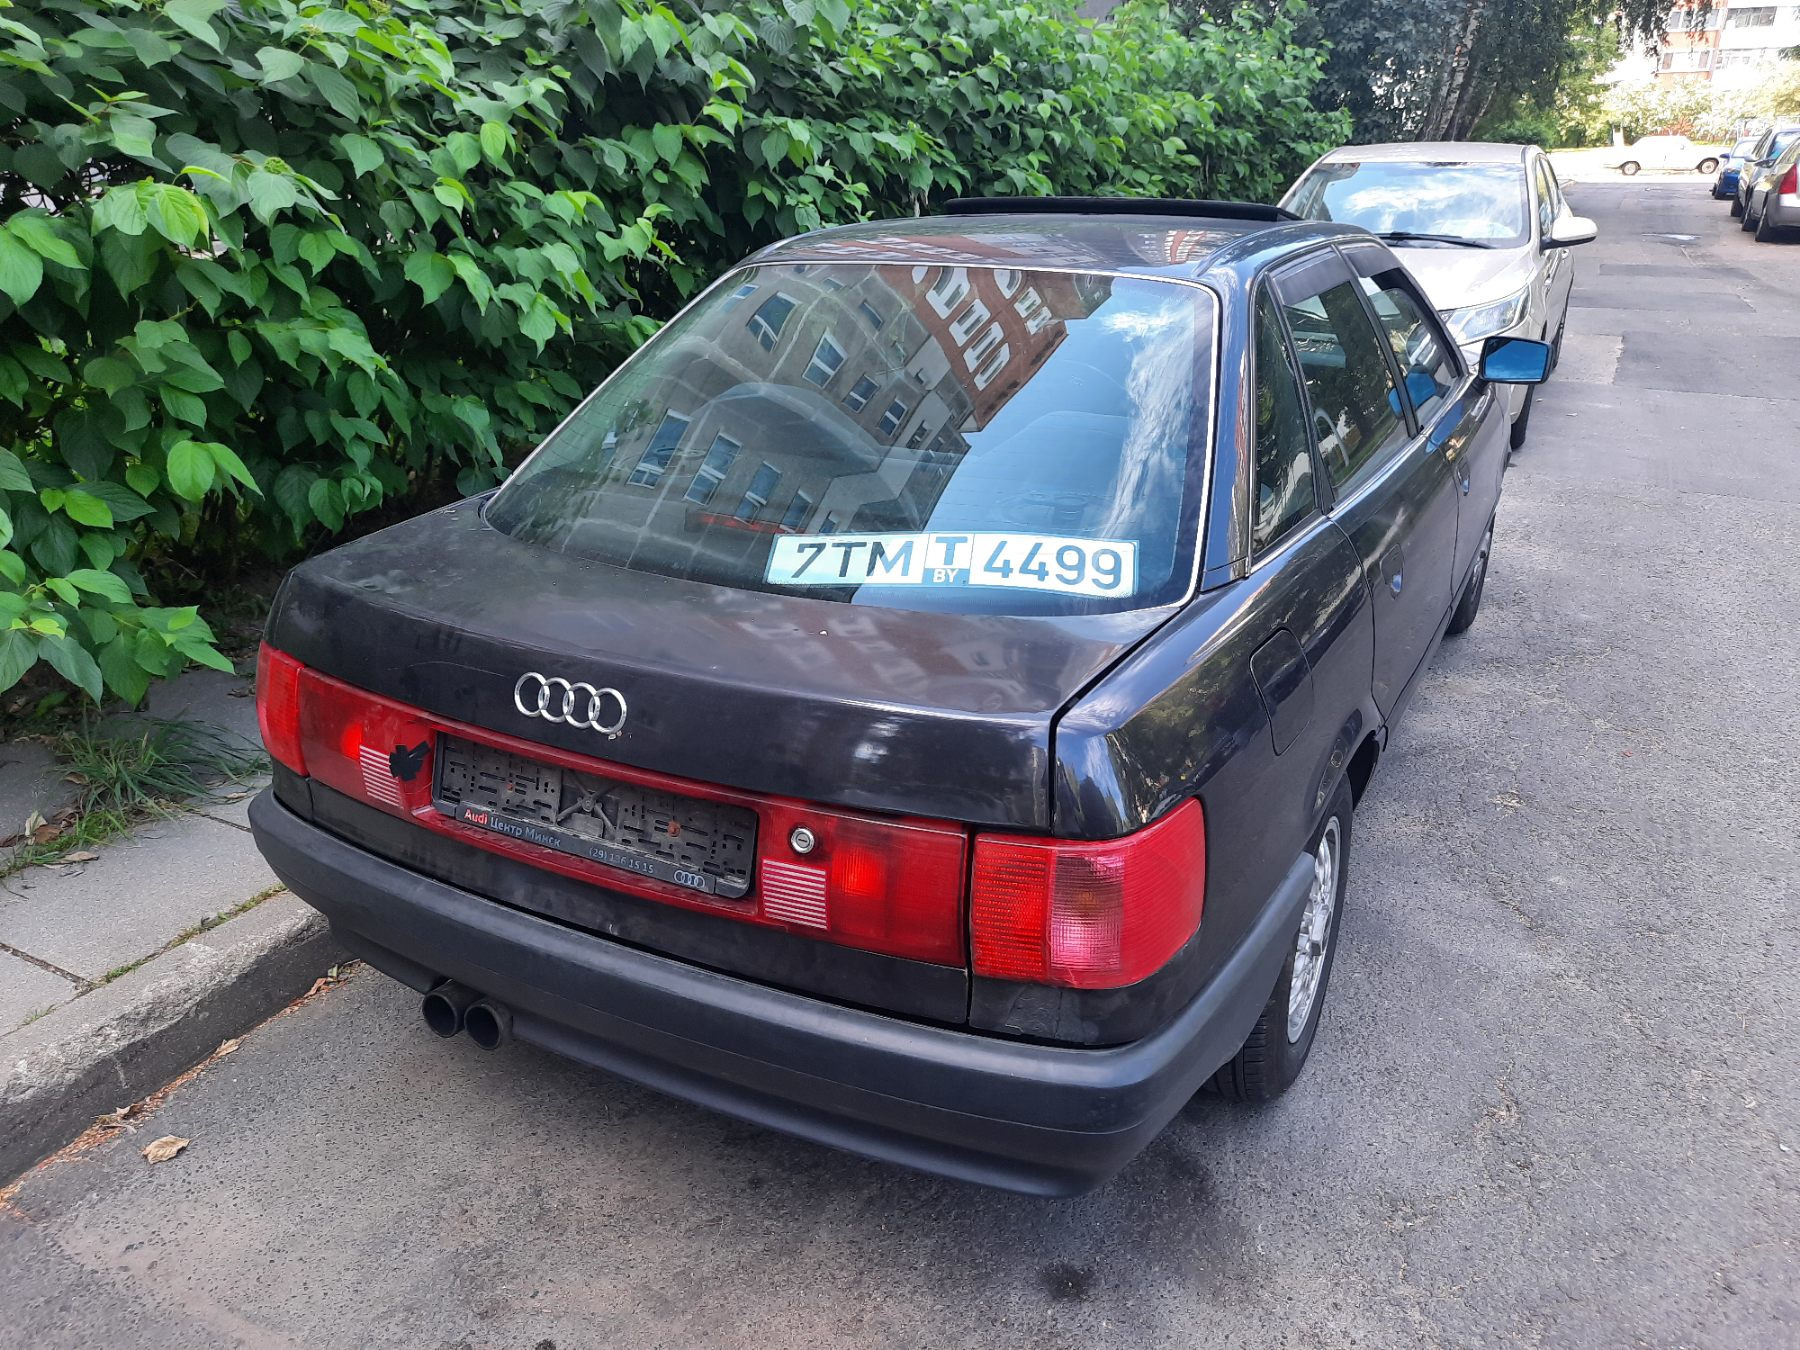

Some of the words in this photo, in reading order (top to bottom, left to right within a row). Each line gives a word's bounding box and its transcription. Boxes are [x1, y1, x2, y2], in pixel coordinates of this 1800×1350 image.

[791, 540, 915, 579] 7TM
[935, 536, 970, 566] T
[983, 540, 1123, 590] 4499
[932, 569, 957, 584] BY
[464, 808, 488, 825] Audi
[490, 816, 523, 837] Центр
[525, 826, 561, 847] Минск
